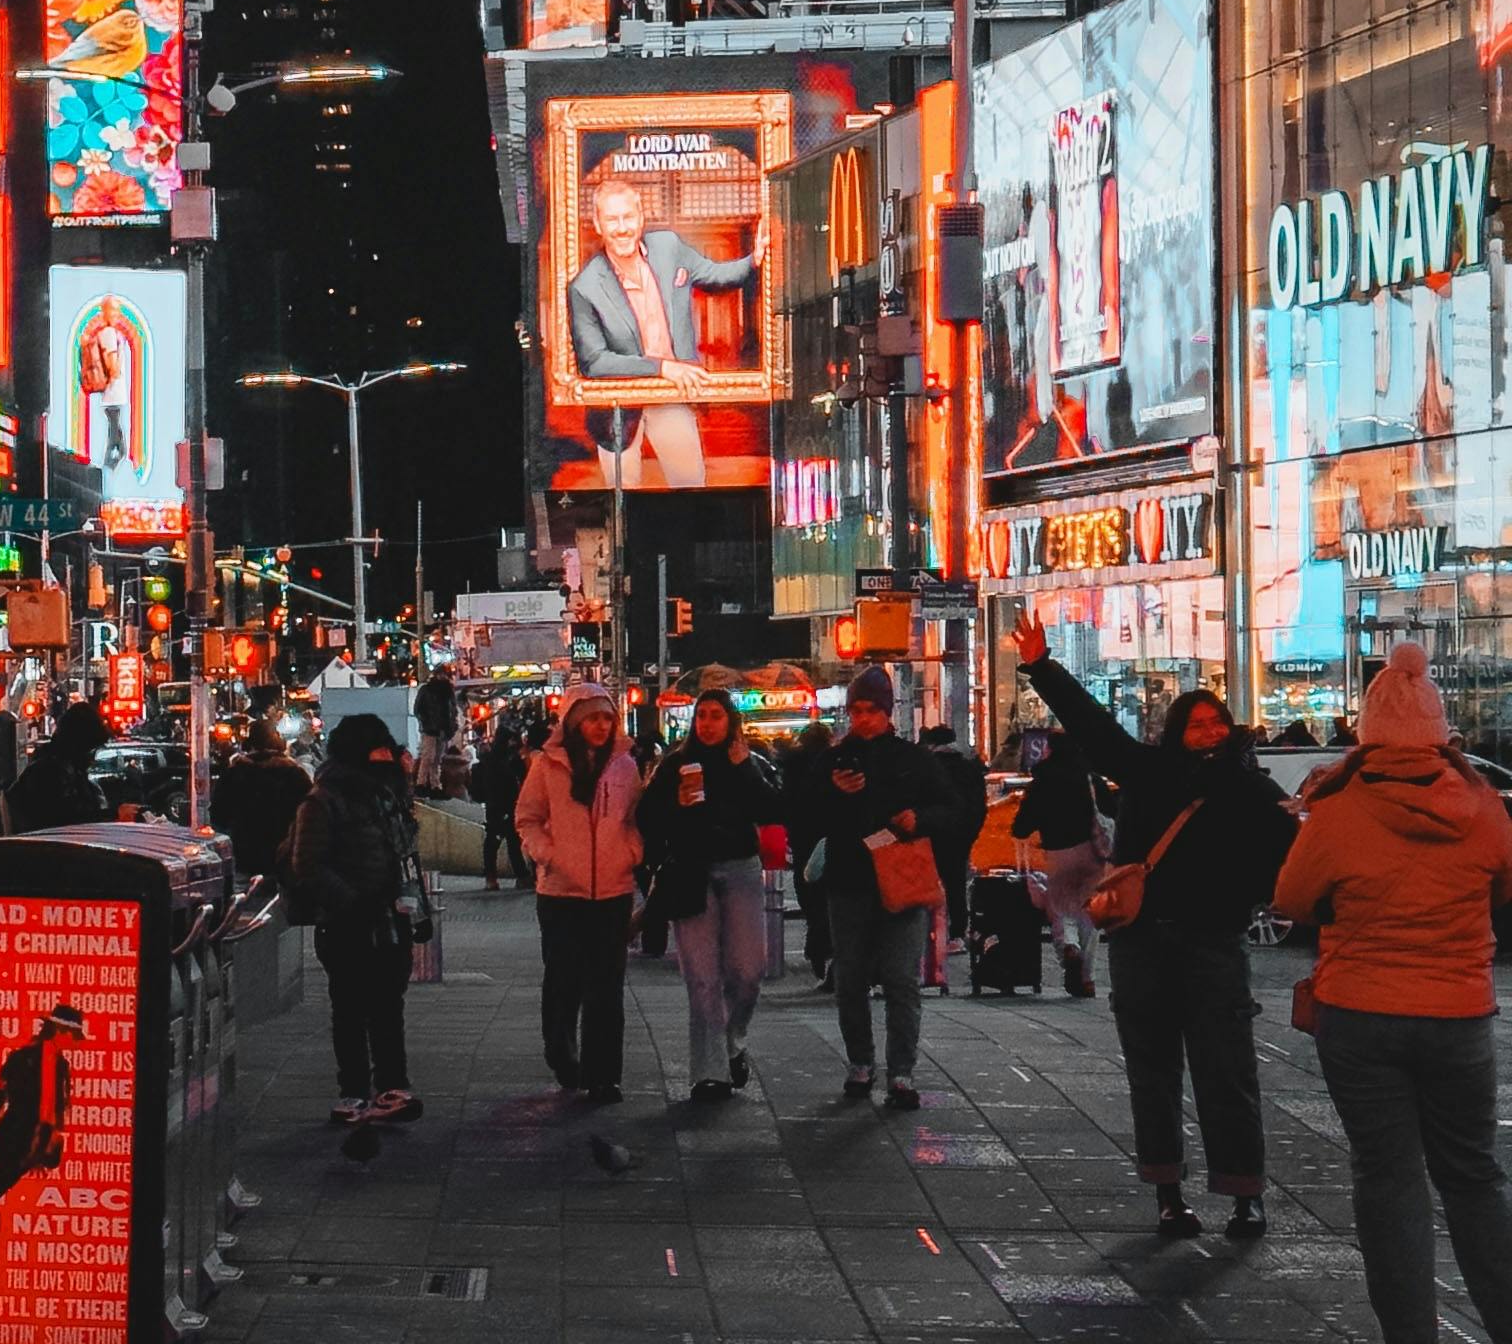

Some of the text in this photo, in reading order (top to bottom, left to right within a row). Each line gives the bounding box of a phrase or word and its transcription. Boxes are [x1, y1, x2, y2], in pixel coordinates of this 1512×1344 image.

[630, 134, 711, 154] LORD IVAR
[613, 152, 728, 173] MOUNTBATTEN
[52, 213, 161, 227] #OUTFRONTPRIME
[1268, 143, 1494, 313] OLD NAVY
[24, 503, 50, 526] 44
[1348, 526, 1442, 579] OLD NAVY
[90, 621, 119, 661] R
[117, 657, 137, 698] tkts
[41, 906, 138, 928] MONEY
[14, 932, 137, 958] CRIMINAL
[14, 962, 21, 983] I
[24, 963, 64, 985] WANT
[68, 964, 95, 987] YOU
[100, 966, 137, 988] BACK
[27, 991, 62, 1011] THE
[70, 993, 136, 1016] BOOGIE
[32, 1018, 96, 1041] FL
[108, 1021, 135, 1042] IT
[62, 1050, 107, 1072] BOUT
[111, 1052, 135, 1073] US
[65, 1106, 133, 1128] IRROR
[74, 1132, 132, 1156] ENOUGH
[65, 1159, 84, 1181] OR
[88, 1161, 132, 1184] WHITE
[36, 1186, 130, 1211] ABC
[12, 1214, 129, 1239] NATURE
[7, 1242, 129, 1266] IN MOSCOW
[6, 1268, 31, 1290] THE
[33, 1270, 65, 1293] LOVE
[68, 1270, 94, 1293] YOU
[96, 1272, 128, 1294] SAVE
[35, 1297, 60, 1319] BE
[64, 1298, 127, 1322] THERE
